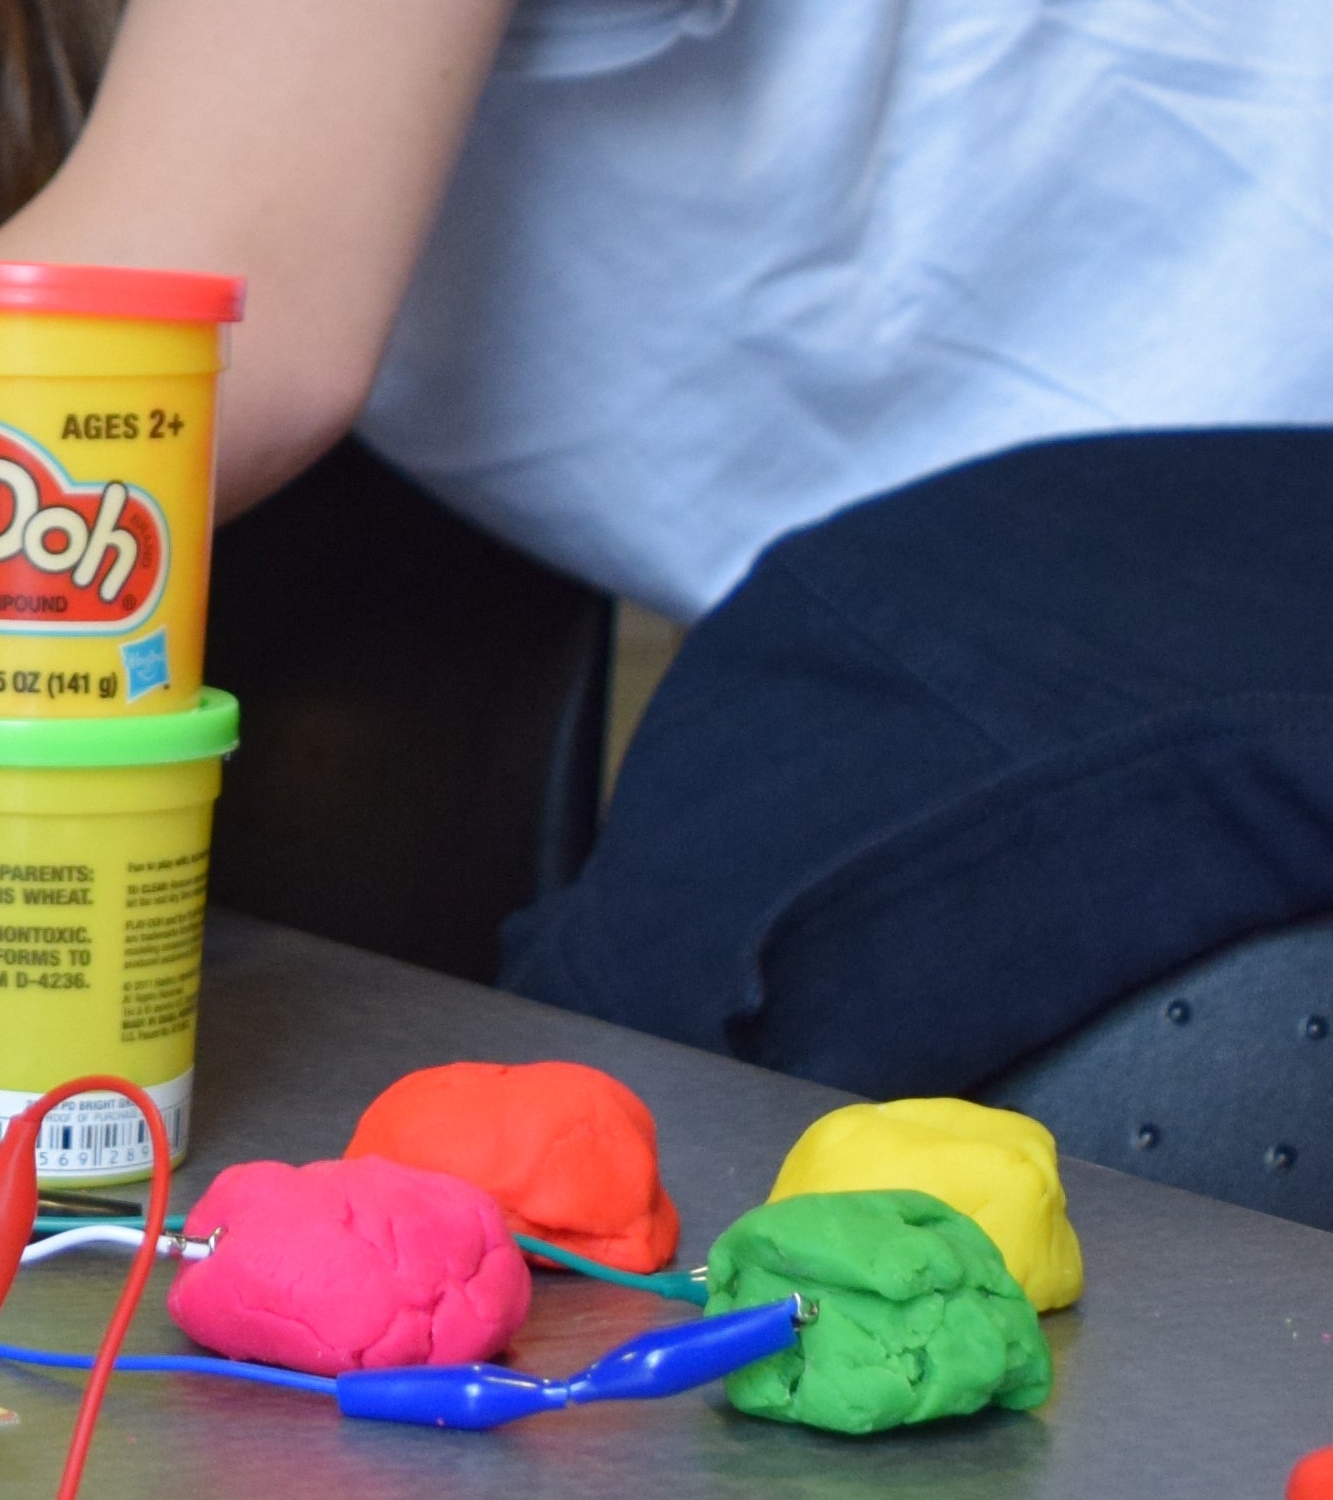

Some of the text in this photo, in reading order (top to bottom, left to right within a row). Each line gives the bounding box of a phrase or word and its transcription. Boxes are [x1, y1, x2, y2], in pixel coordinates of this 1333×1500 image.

[61, 408, 185, 440] AGES 2+
[12, 670, 41, 694] OZ
[47, 671, 91, 698] (141
[98, 671, 118, 698] g)
[22, 887, 94, 906] WHEAT.
[69, 950, 92, 966] TO
[15, 970, 91, 989] D-4236.
